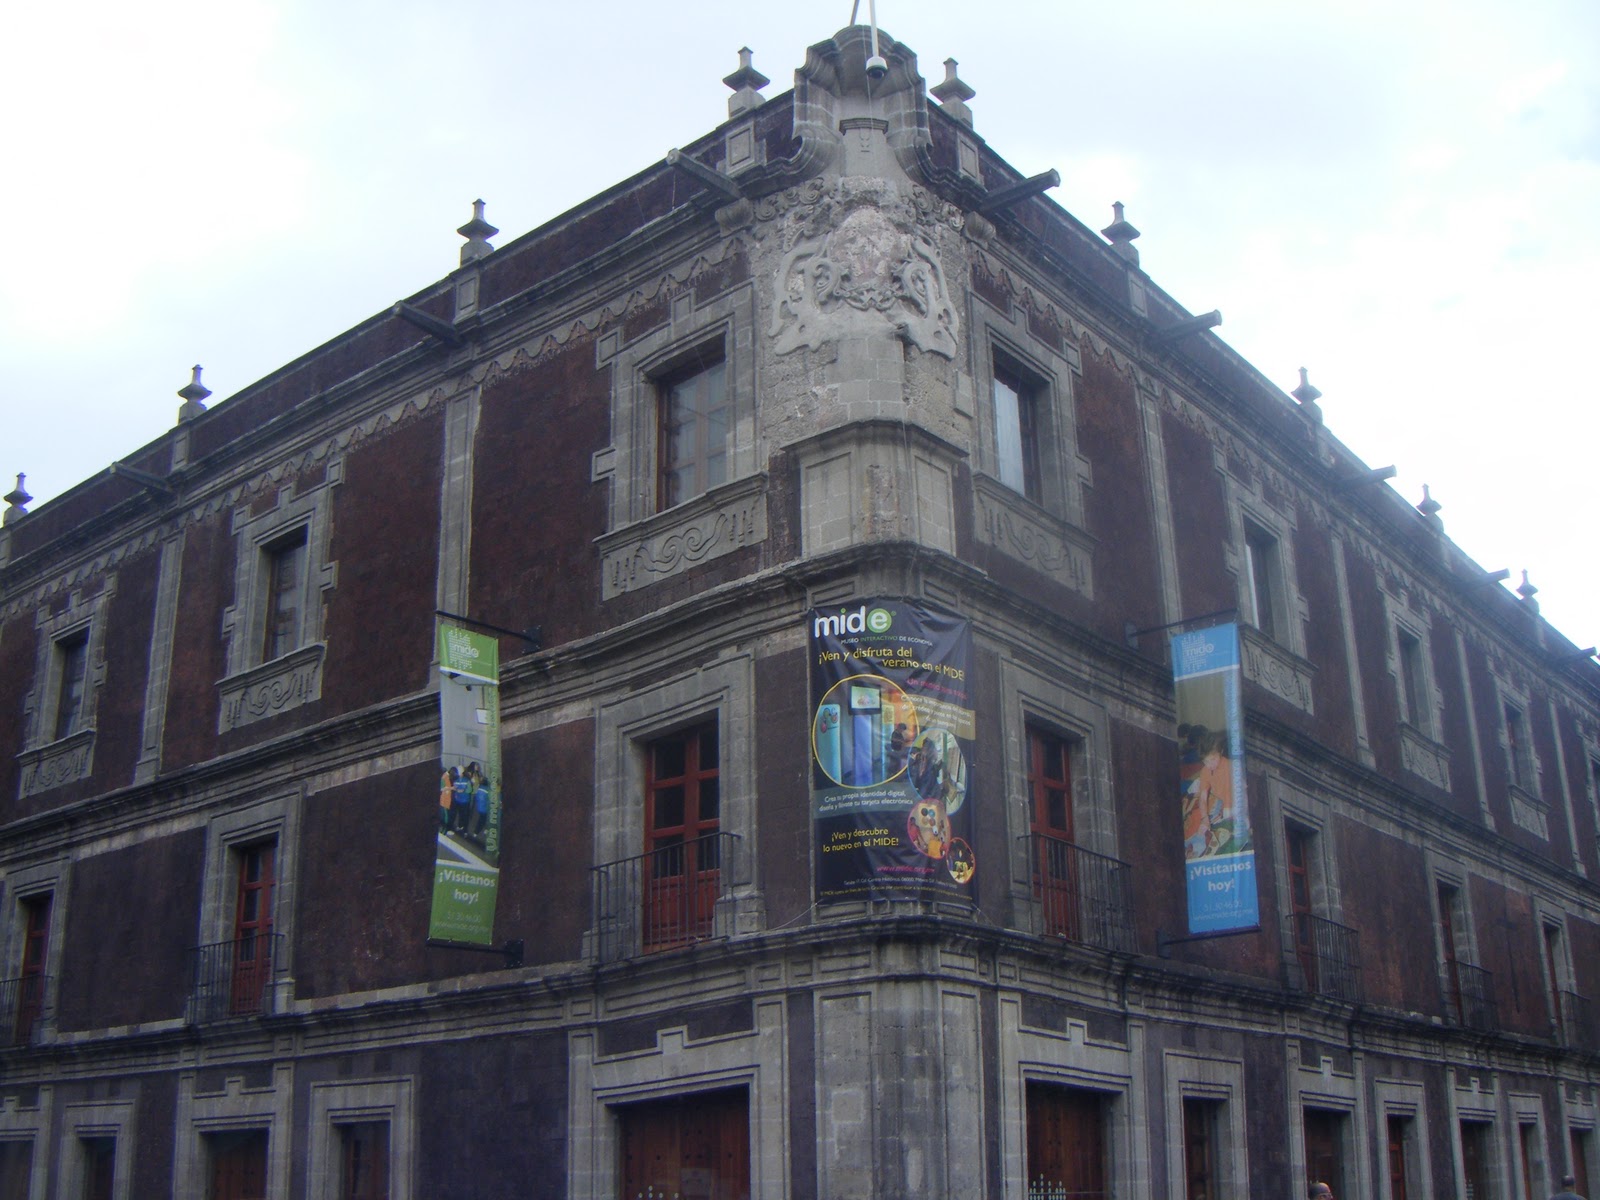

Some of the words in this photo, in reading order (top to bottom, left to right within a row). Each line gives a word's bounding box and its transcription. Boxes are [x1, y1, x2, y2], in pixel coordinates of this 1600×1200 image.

[815, 605, 890, 638] mide
[841, 637, 859, 645] MUSEO
[860, 635, 898, 643] INTERACTIVO
[819, 651, 840, 665] ¡Ven
[843, 651, 850, 662] y
[853, 646, 893, 659] disfruta
[897, 646, 913, 657] del
[882, 659, 919, 669] verano
[922, 662, 933, 671] en
[935, 664, 942, 674] el
[860, 790, 887, 798] identidad
[832, 832, 847, 842] ¡Ven
[848, 831, 852, 840] y
[853, 827, 889, 837] descubre
[823, 844, 831, 852] lo
[832, 842, 853, 851] nuevo
[873, 837, 899, 846] MIDE!
[1190, 860, 1252, 880] ¡Visítanos
[438, 869, 496, 887] ¡Visítanos
[1208, 878, 1235, 893] hoy!
[455, 888, 479, 905] hoy!
